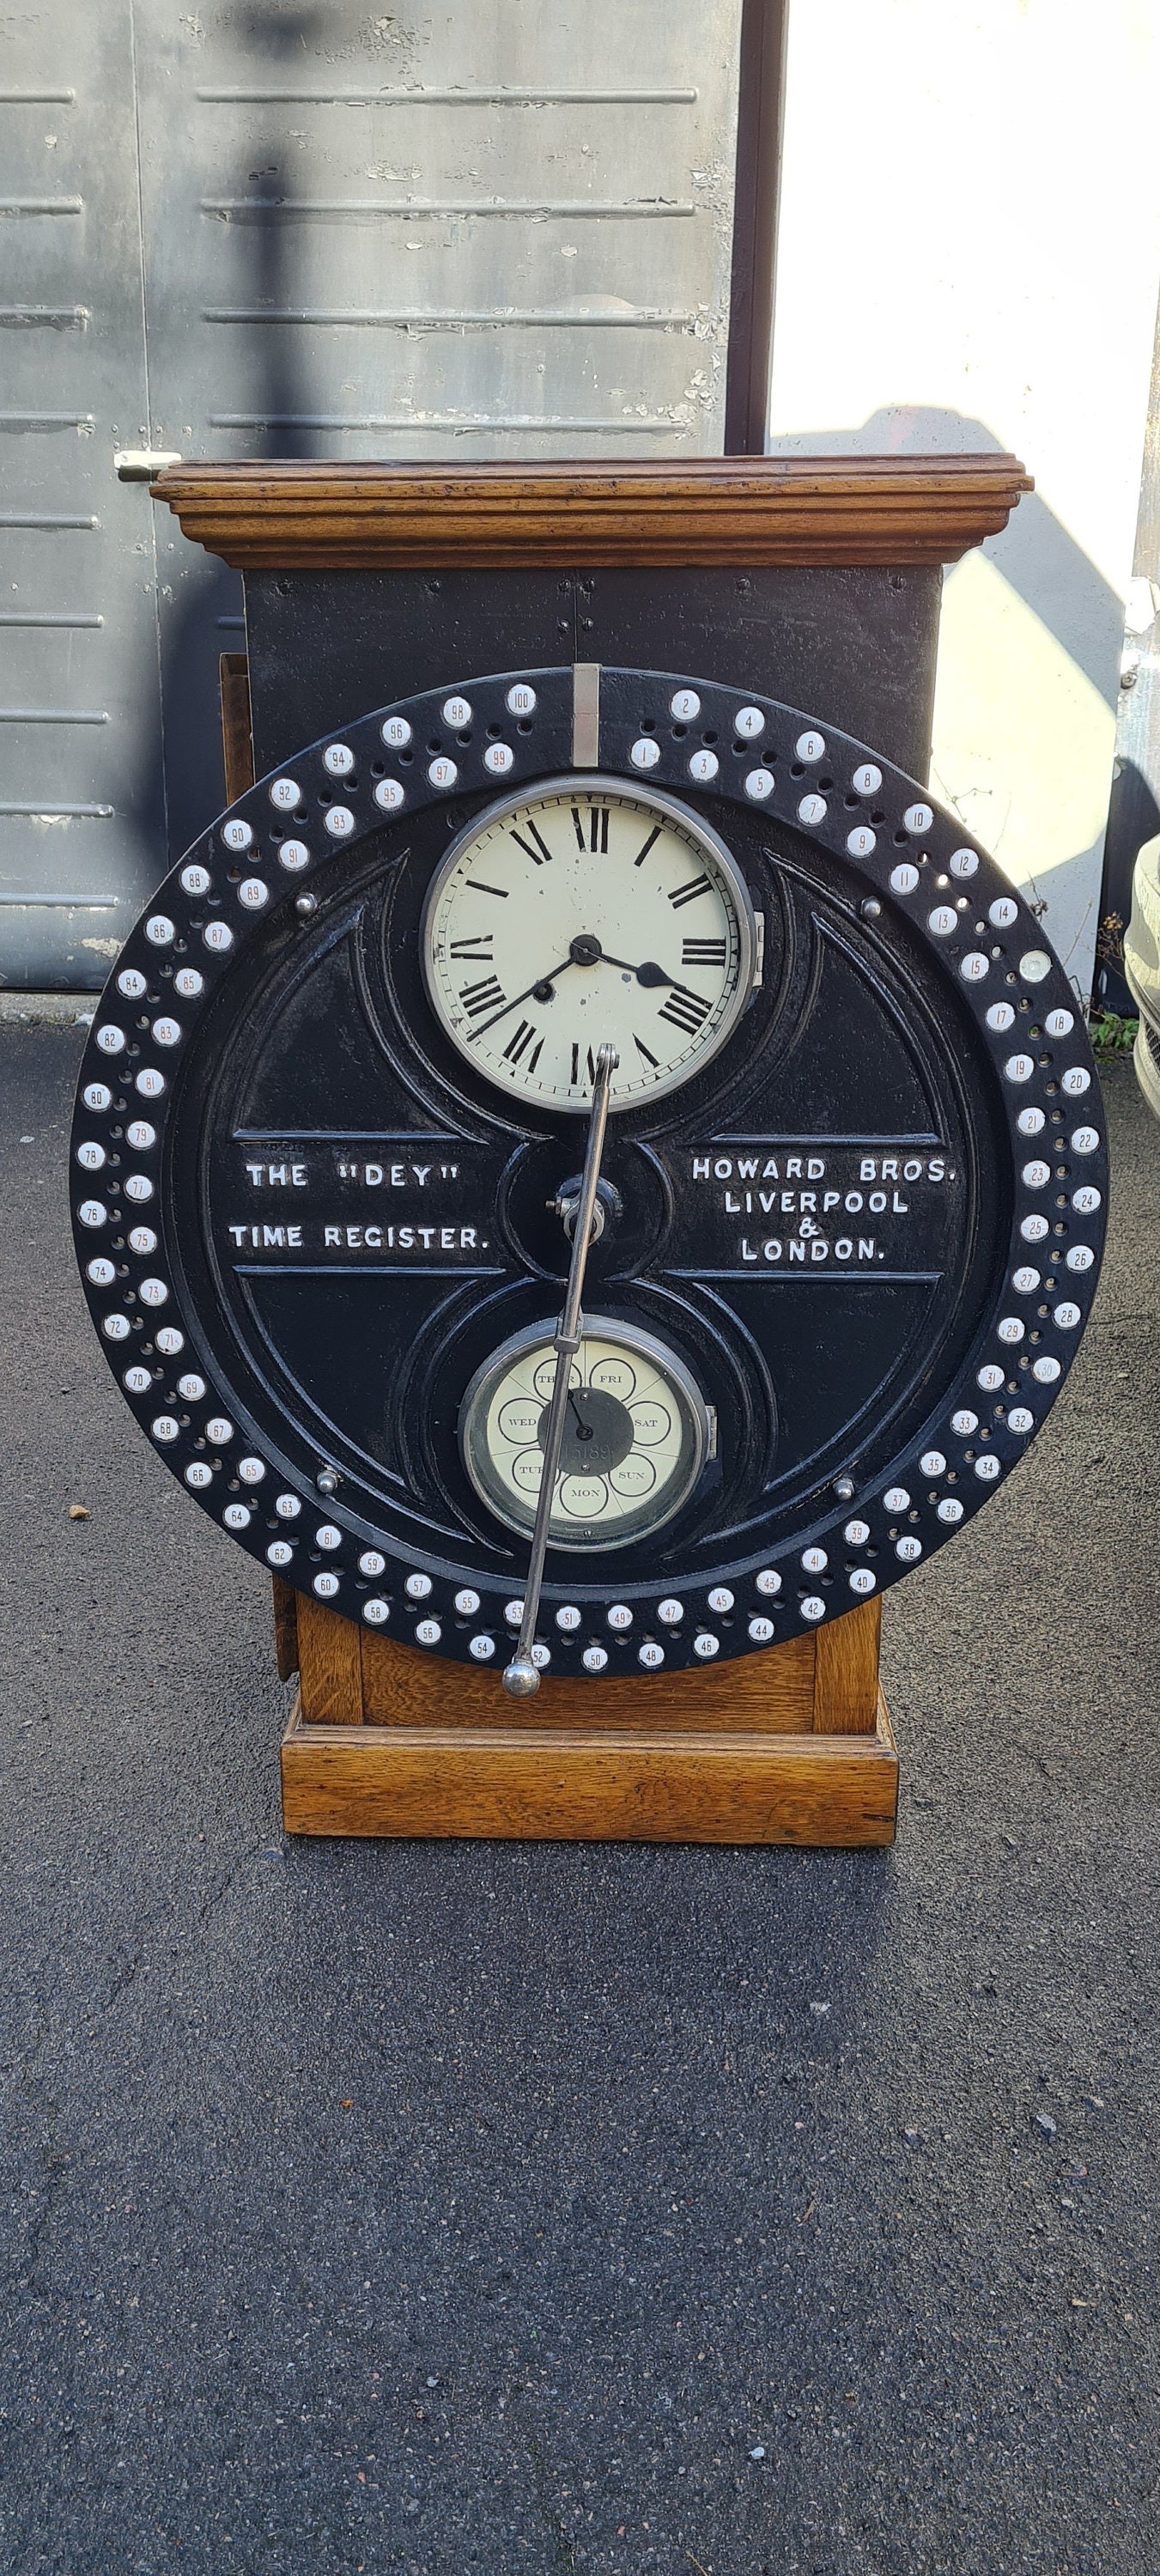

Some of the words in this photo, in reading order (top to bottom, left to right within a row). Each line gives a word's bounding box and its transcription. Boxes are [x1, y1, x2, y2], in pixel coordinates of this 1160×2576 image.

[514, 692, 529, 708] 100
[451, 704, 464, 720] 98
[390, 723, 403, 739] 96
[332, 751, 346, 768] 94
[493, 750, 506, 766] 99
[436, 765, 448, 781] 97
[279, 786, 292, 801] 92
[383, 787, 396, 802] 95
[333, 814, 346, 829] 93
[914, 811, 924, 827] 10
[232, 827, 244, 843] 90
[288, 848, 298, 864] 91
[959, 855, 969, 872] 12
[189, 872, 201, 888] 88
[901, 871, 908, 887] 11
[247, 885, 259, 901] 89
[999, 905, 1009, 920] 14
[938, 914, 949, 930] 13
[154, 924, 166, 939] 86
[211, 928, 223, 943] 87
[681, 936, 726, 967] III
[970, 960, 981, 975] 15
[125, 976, 138, 991] 84
[183, 975, 195, 990] 85
[996, 1010, 1007, 1024] 17
[1054, 1016, 1065, 1030] 18
[104, 1032, 117, 1047] 82
[160, 1025, 173, 1040] 83
[1016, 1060, 1025, 1075] 19
[146, 1077, 155, 1091] 81
[1070, 1074, 1083, 1089] 20
[90, 1091, 102, 1105] 80
[1027, 1115, 1037, 1130] 21
[135, 1127, 147, 1142] 79
[1078, 1133, 1091, 1148] 22
[85, 1150, 97, 1163] 78
[246, 1164, 307, 1187] THE
[692, 1157, 826, 1181] HOWARD
[859, 1158, 957, 1182] BROS.
[1031, 1167, 1044, 1182] 23
[132, 1181, 143, 1195] 77
[725, 1191, 908, 1213] LIVERPOOL
[1081, 1194, 1094, 1208] 24
[86, 1208, 98, 1221] 76
[799, 1217, 820, 1238] &
[1029, 1221, 1042, 1236] 25
[137, 1233, 149, 1247] 75
[228, 1225, 302, 1247] TIME
[325, 1226, 489, 1249] REGISTER.
[741, 1238, 885, 1262] LONDON.
[1074, 1253, 1087, 1267] 26
[94, 1266, 107, 1279] 74
[1019, 1273, 1033, 1287] 27
[148, 1285, 159, 1299] 73
[1060, 1309, 1073, 1323] 28
[110, 1321, 121, 1334] 72
[1006, 1324, 1018, 1338] 29
[165, 1334, 173, 1346] 71
[132, 1373, 143, 1387] 70
[986, 1372, 996, 1385] 31
[186, 1381, 197, 1394] 69
[634, 1419, 658, 1427] SAT
[958, 1417, 970, 1430] 33
[1014, 1414, 1026, 1428] 32
[160, 1422, 172, 1435] 68
[213, 1425, 224, 1437] 67
[246, 1464, 257, 1477] 65
[927, 1458, 940, 1472] 35
[981, 1461, 993, 1475] 34
[192, 1468, 204, 1482] 66
[618, 1471, 645, 1479] SUN
[571, 1489, 600, 1498] MON
[892, 1494, 903, 1507] 37
[282, 1500, 293, 1514] 63
[944, 1505, 957, 1518] 36
[231, 1510, 243, 1522] 64
[324, 1532, 332, 1546] 61
[851, 1527, 863, 1540] 39
[274, 1547, 286, 1560] 62
[903, 1543, 915, 1557] 38
[367, 1558, 378, 1571] 59
[811, 1554, 819, 1568] 41
[320, 1578, 331, 1591] 60
[413, 1580, 423, 1593] 57
[763, 1577, 775, 1589] 43
[856, 1576, 868, 1589] 40
[462, 1596, 473, 1609] 55
[716, 1595, 727, 1607] 45
[370, 1606, 381, 1619] 58
[512, 1607, 523, 1619] 53
[665, 1606, 676, 1619] 47
[807, 1602, 818, 1615] 42
[563, 1613, 573, 1625] 51
[614, 1612, 626, 1625] 49
[422, 1626, 434, 1639] 56
[755, 1624, 768, 1637] 44
[477, 1642, 489, 1655] 54
[701, 1640, 712, 1653] 46
[533, 1650, 544, 1663] 52
[590, 1654, 601, 1667] 50
[646, 1649, 657, 1662] 48
